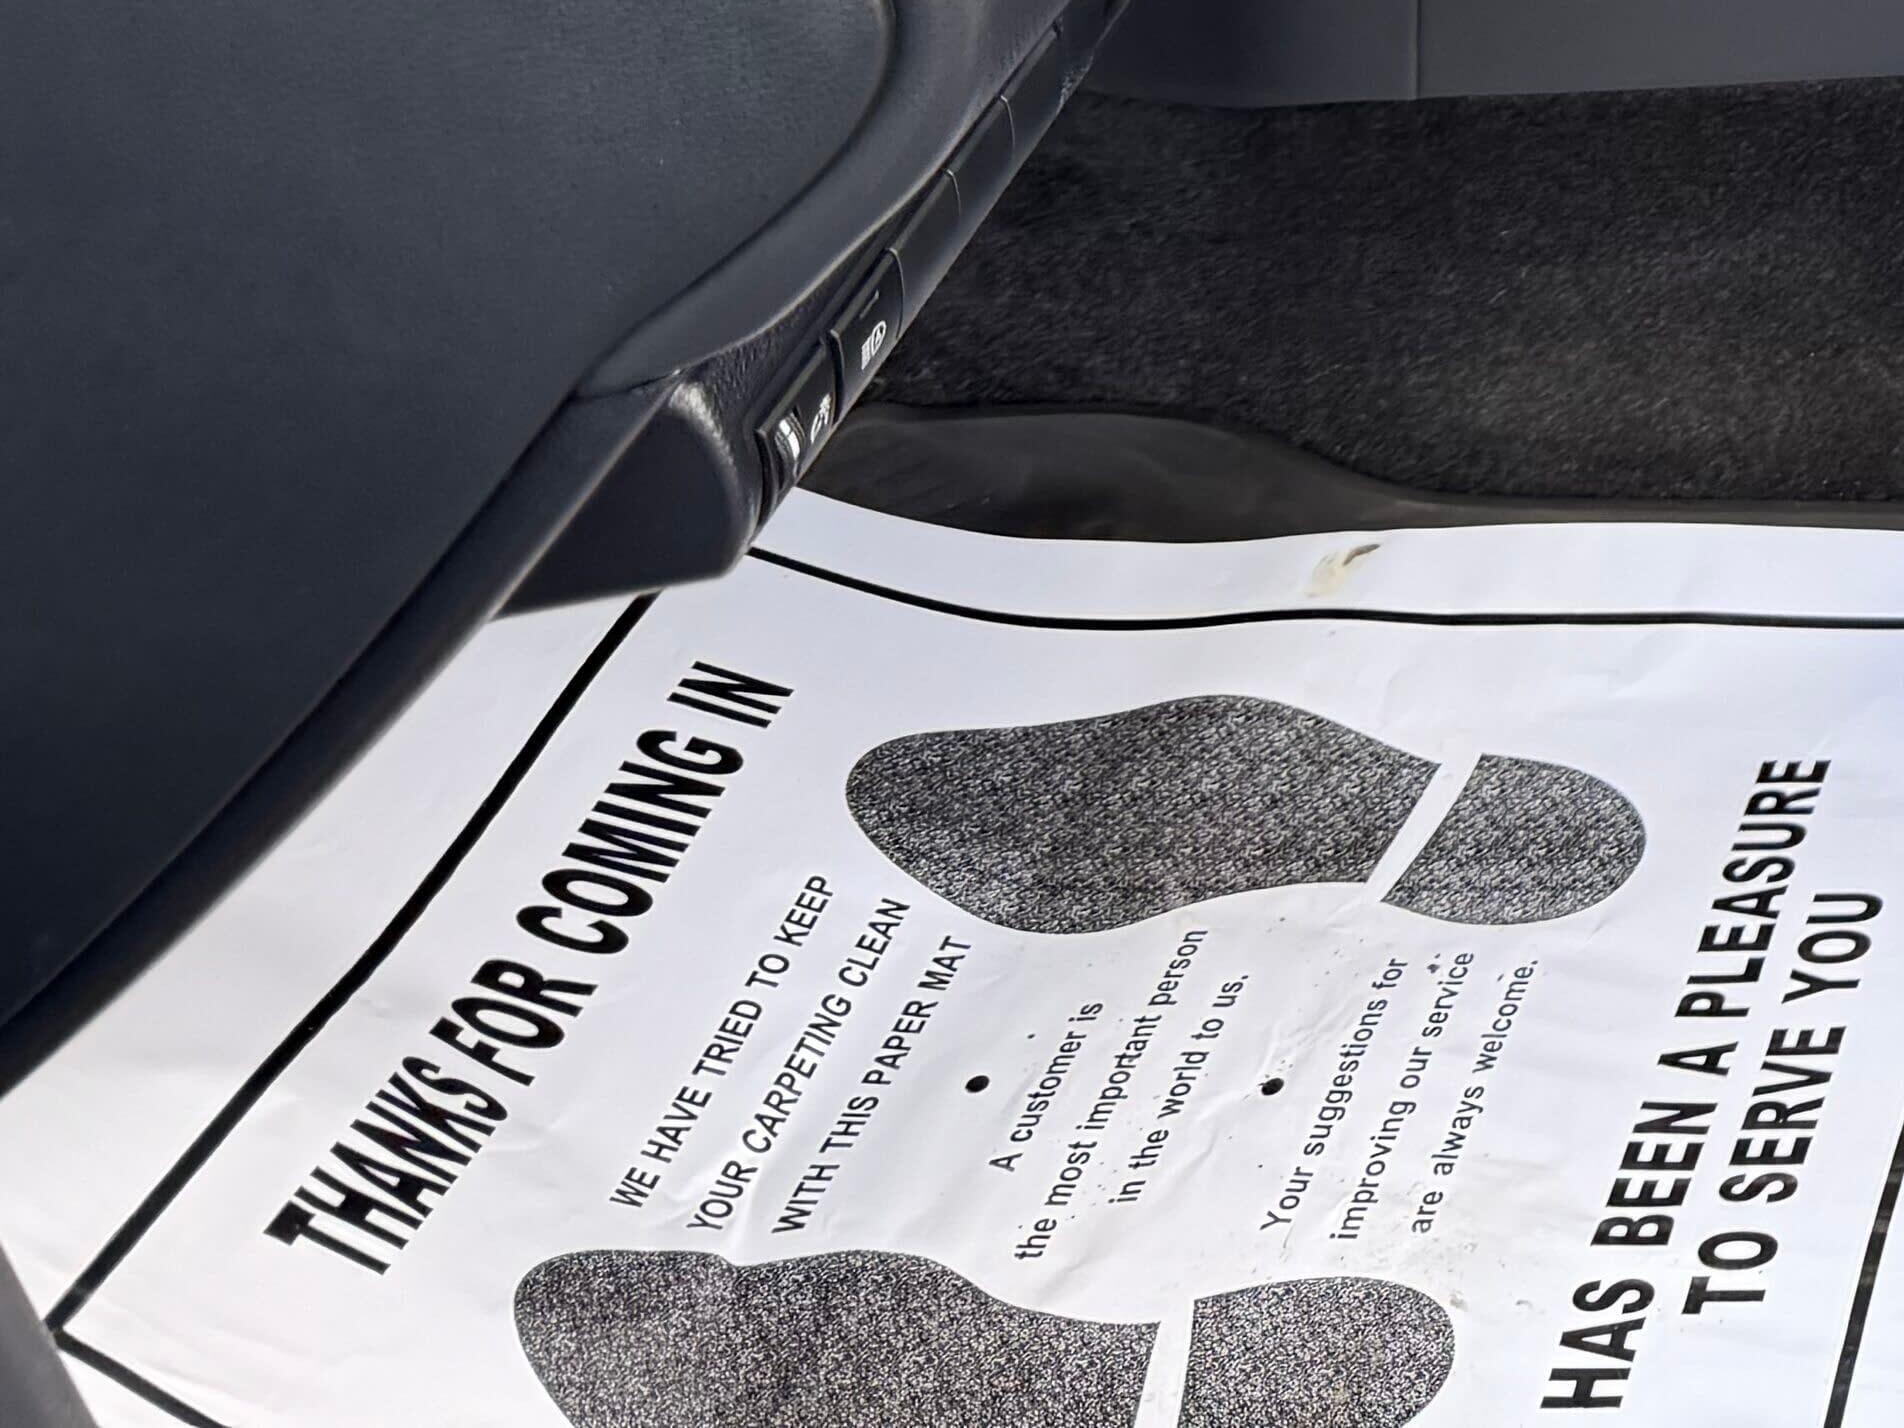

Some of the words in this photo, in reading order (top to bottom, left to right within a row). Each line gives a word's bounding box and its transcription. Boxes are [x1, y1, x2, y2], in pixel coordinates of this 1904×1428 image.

[263, 1056, 508, 1276] THANKS
[429, 959, 599, 1086] FOR
[516, 729, 744, 955] COMING
[667, 661, 795, 729] IN
[1674, 757, 1832, 1019] PLEASURE
[1781, 891, 1885, 1005] YOU
[609, 1166, 660, 1208] WE
[641, 1085, 712, 1163] HAVE
[692, 999, 763, 1076] TRIED
[745, 953, 790, 988] TO
[773, 874, 834, 946] KEEP
[686, 1159, 758, 1230] YOUR
[742, 993, 852, 1154] CARPETING
[838, 897, 911, 987] CLEAN
[771, 1163, 841, 1234] WITH
[819, 1095, 880, 1154] THIS
[860, 999, 938, 1086] PAPER
[917, 935, 972, 991] MAT
[988, 1152, 1024, 1173] A
[1009, 1030, 1088, 1143] customer
[1068, 1002, 1104, 1023] is
[1014, 1217, 1058, 1260] the
[1044, 1140, 1098, 1207] most
[1075, 1014, 1163, 1130] important
[1148, 929, 1209, 1007] person
[1108, 1180, 1147, 1204] in
[1128, 1128, 1170, 1170] the
[1157, 1050, 1210, 1119] world
[1190, 1017, 1225, 1041] to
[1212, 974, 1250, 1008] us.
[1259, 1165, 1315, 1231] Your
[1303, 998, 1388, 1157] suggestions
[1371, 957, 1409, 991] for
[1329, 1099, 1417, 1240] improving
[1400, 1045, 1434, 1090] our
[1421, 951, 1475, 1038] service
[1410, 1190, 1445, 1234] are
[1431, 1085, 1486, 1176] always
[1471, 959, 1539, 1074] welcome.
[1656, 1039, 1741, 1078] A
[1717, 1023, 1848, 1204] SERVE
[1589, 1099, 1719, 1248] BEEN
[1681, 1228, 1780, 1315] TO
[1539, 1278, 1656, 1410] HAS
